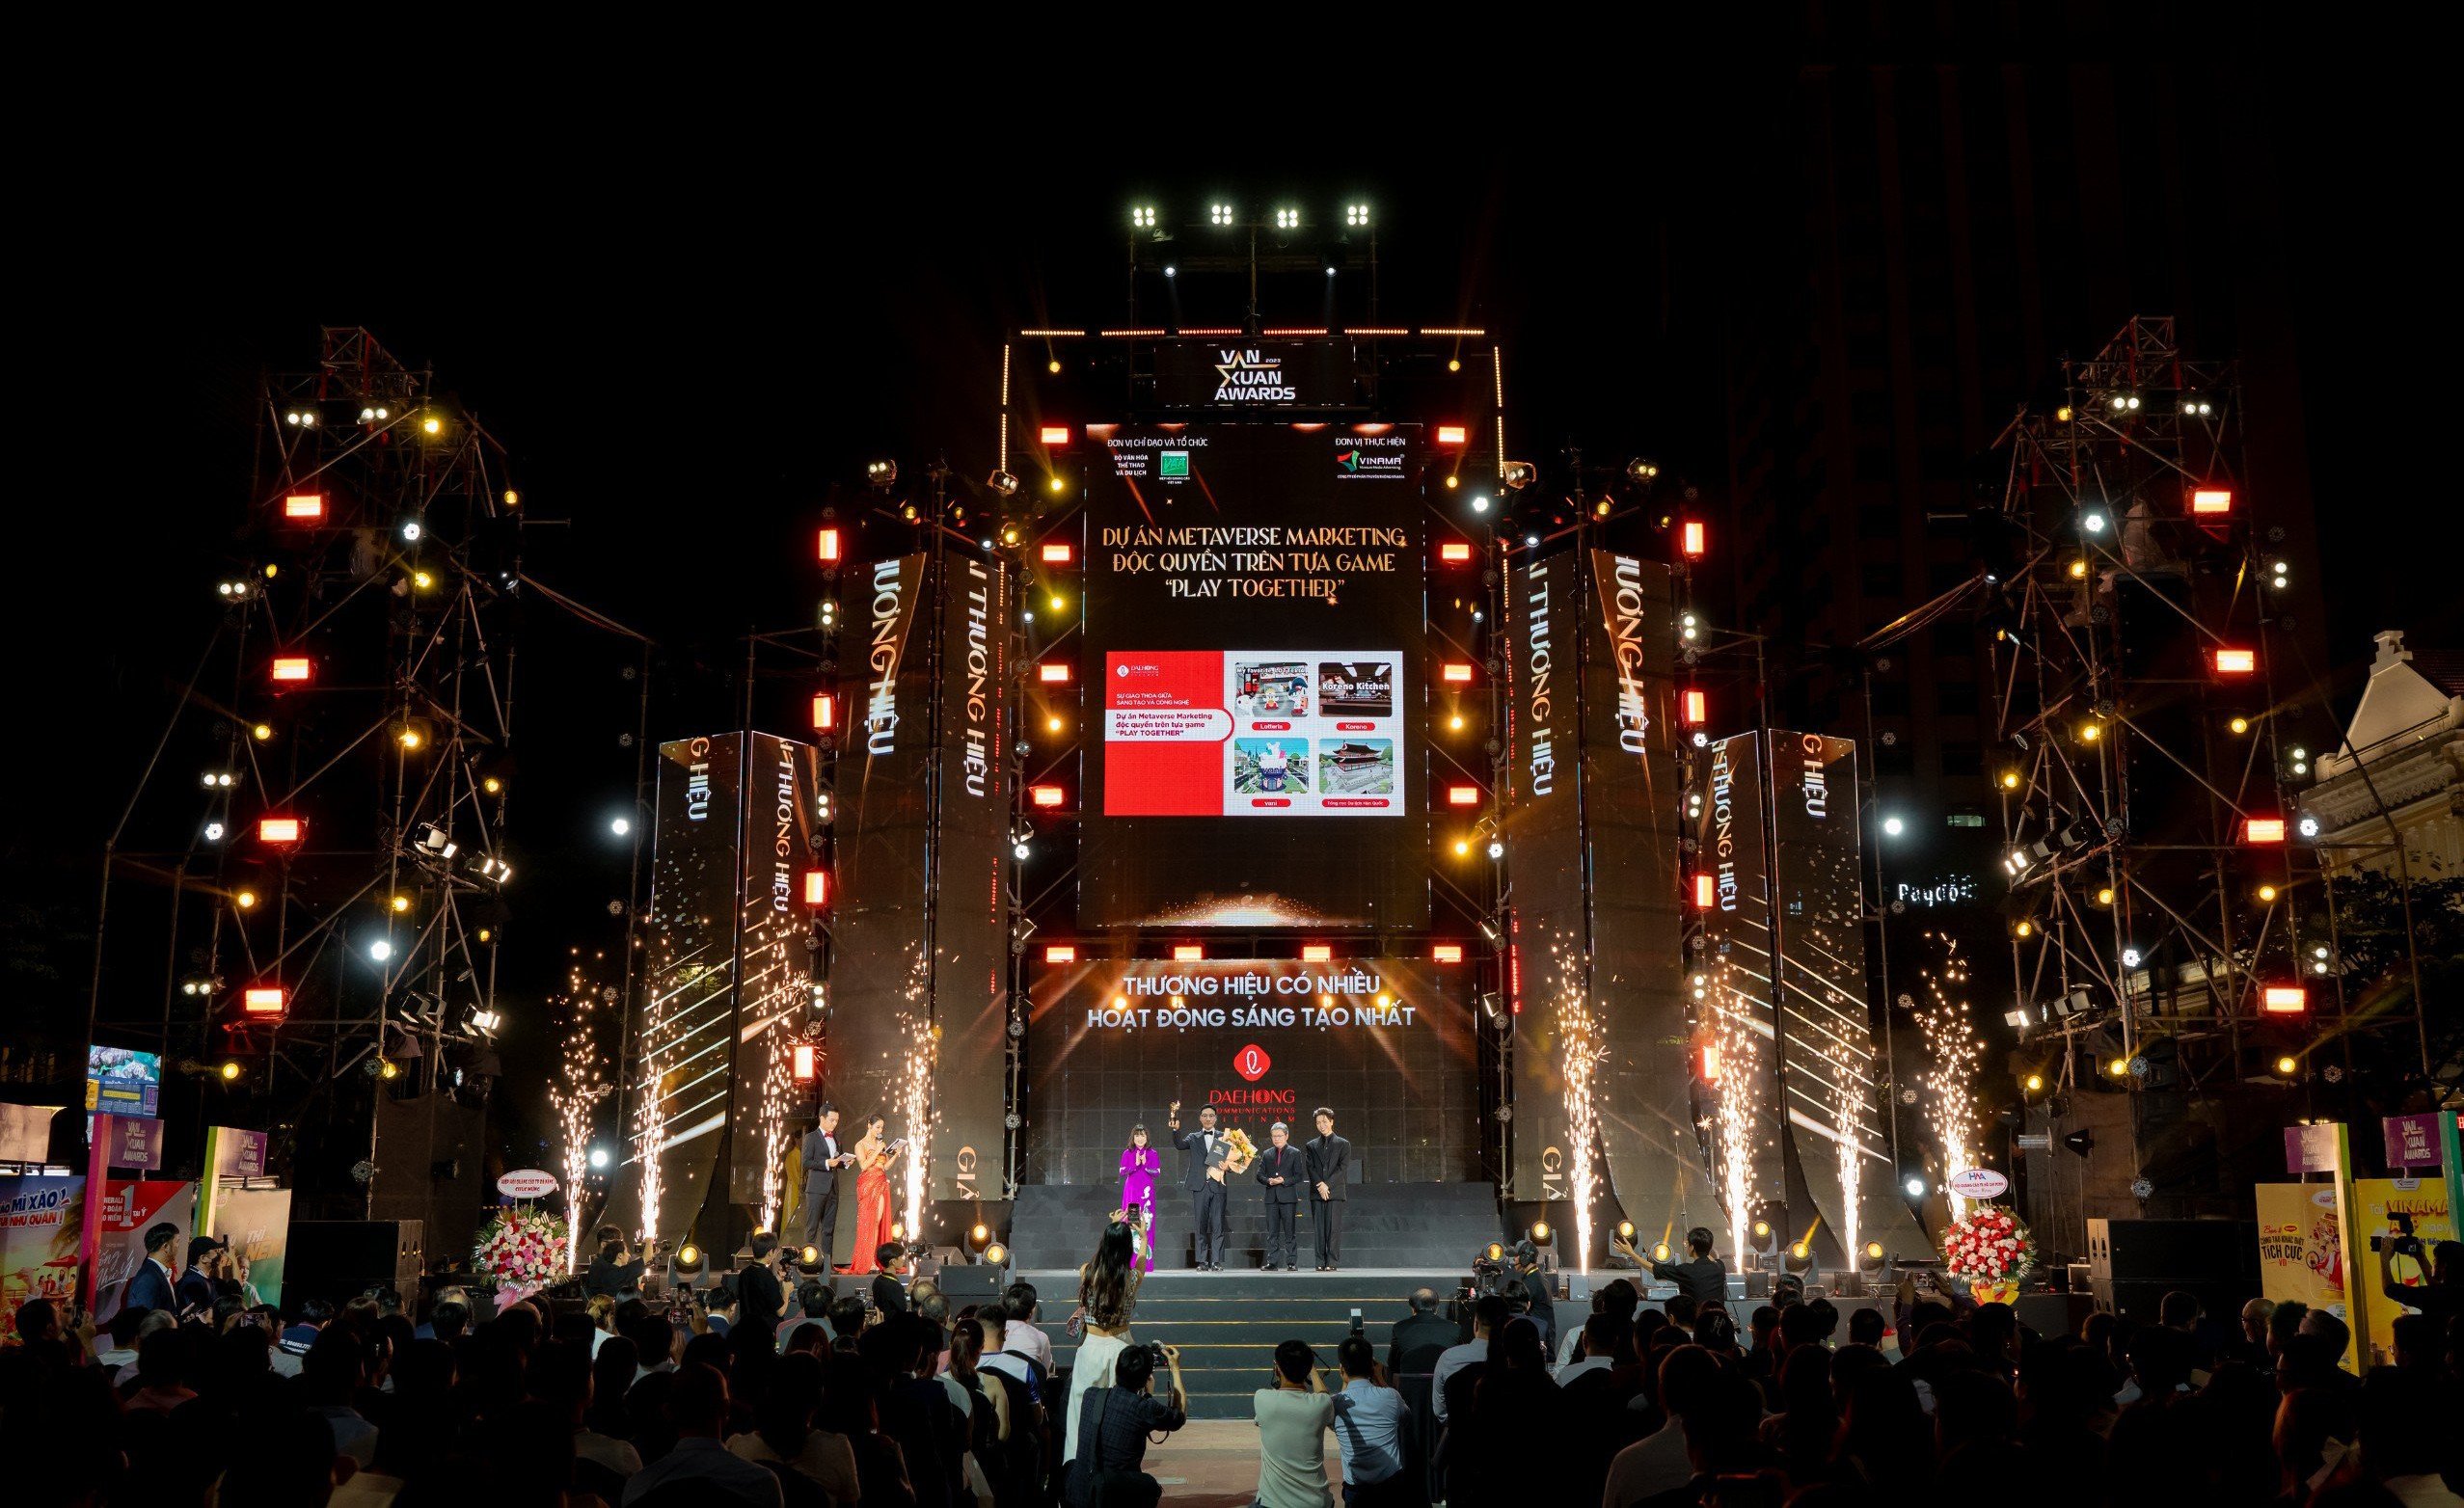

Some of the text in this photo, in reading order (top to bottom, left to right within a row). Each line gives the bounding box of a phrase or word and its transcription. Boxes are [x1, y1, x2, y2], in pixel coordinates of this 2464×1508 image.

[1220, 349, 1259, 366] VAN
[1214, 387, 1296, 400] AWARDS
[1222, 371, 1282, 385] XUAN
[1107, 435, 1208, 448] ĐƠN VỊ CHỈ ĐẠO VÀ TỔ CHỨC
[1335, 436, 1406, 447] ĐƠN VỊ THỰC HIỆN
[1103, 525, 1405, 550] DỰ ÁN METAVERSE MARKETING
[1113, 548, 1395, 575] ĐỘC QUYỀN TRÊN TỰA GAME
[966, 587, 988, 722] THƯƠNG
[1530, 580, 1552, 722] THƯƠNG
[1356, 682, 1390, 690] Kitchen
[963, 728, 988, 797] HIỆU
[1530, 727, 1556, 796] HIỆU
[686, 763, 712, 821] HIỆU
[1802, 760, 1828, 817] HIỆU
[775, 757, 795, 857] THƯƠNG
[1713, 755, 1733, 857] THƯƠNG
[772, 862, 792, 912] HIỆU
[1718, 862, 1738, 911] HIỆU
[1123, 967, 1380, 1000] THƯƠNG HIỆU CÓ NHIỀU
[1088, 999, 1415, 1033] HOẠT ĐỘNG SÁNG TẠO NHẤT
[1209, 1089, 1295, 1104] DAEHONG
[123, 1151, 148, 1162] AWARDS
[2404, 1148, 2431, 1160] AWARDS
[120, 1185, 135, 1226] 1
